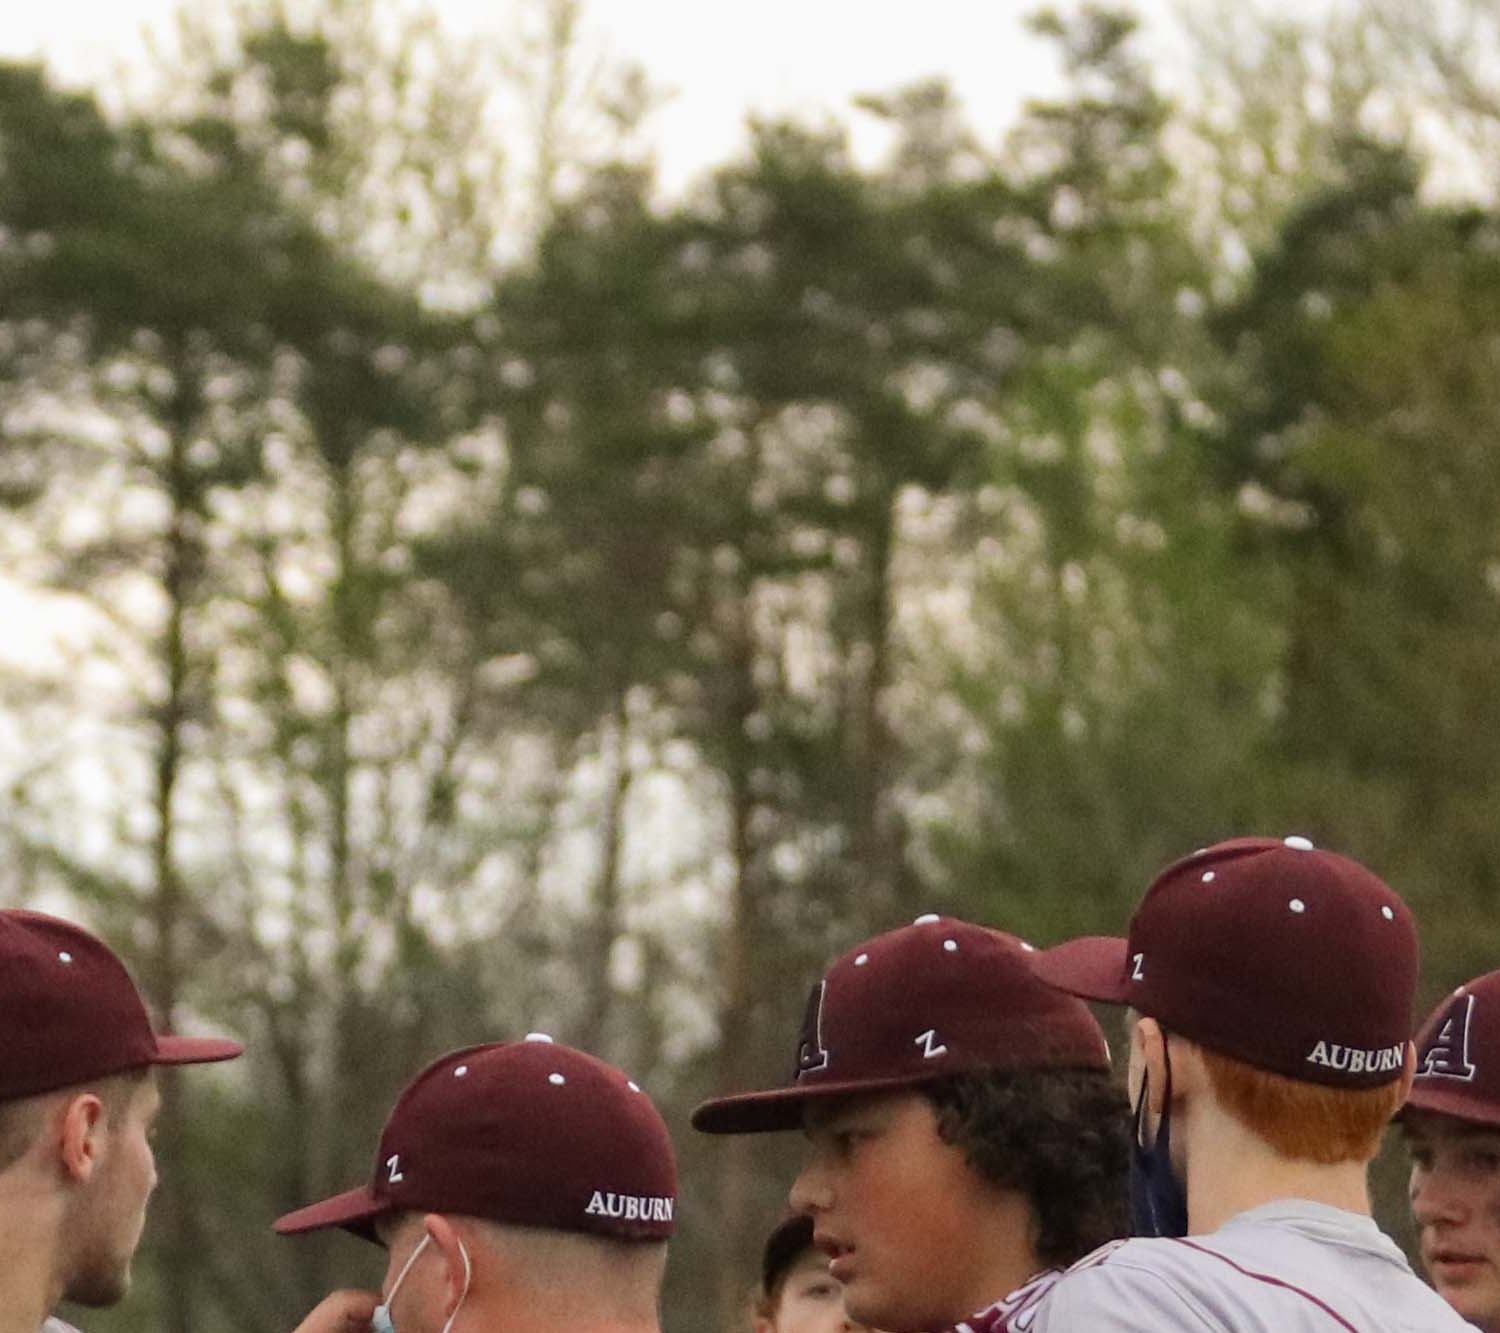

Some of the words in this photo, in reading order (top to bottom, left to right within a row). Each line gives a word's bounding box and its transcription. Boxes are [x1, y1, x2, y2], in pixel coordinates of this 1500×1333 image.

[914, 1028, 948, 1059] Z
[1414, 993, 1477, 1083] A
[1305, 1039, 1408, 1077] AUBURN
[385, 1153, 404, 1184] Z
[584, 1189, 675, 1223] AUBURN
